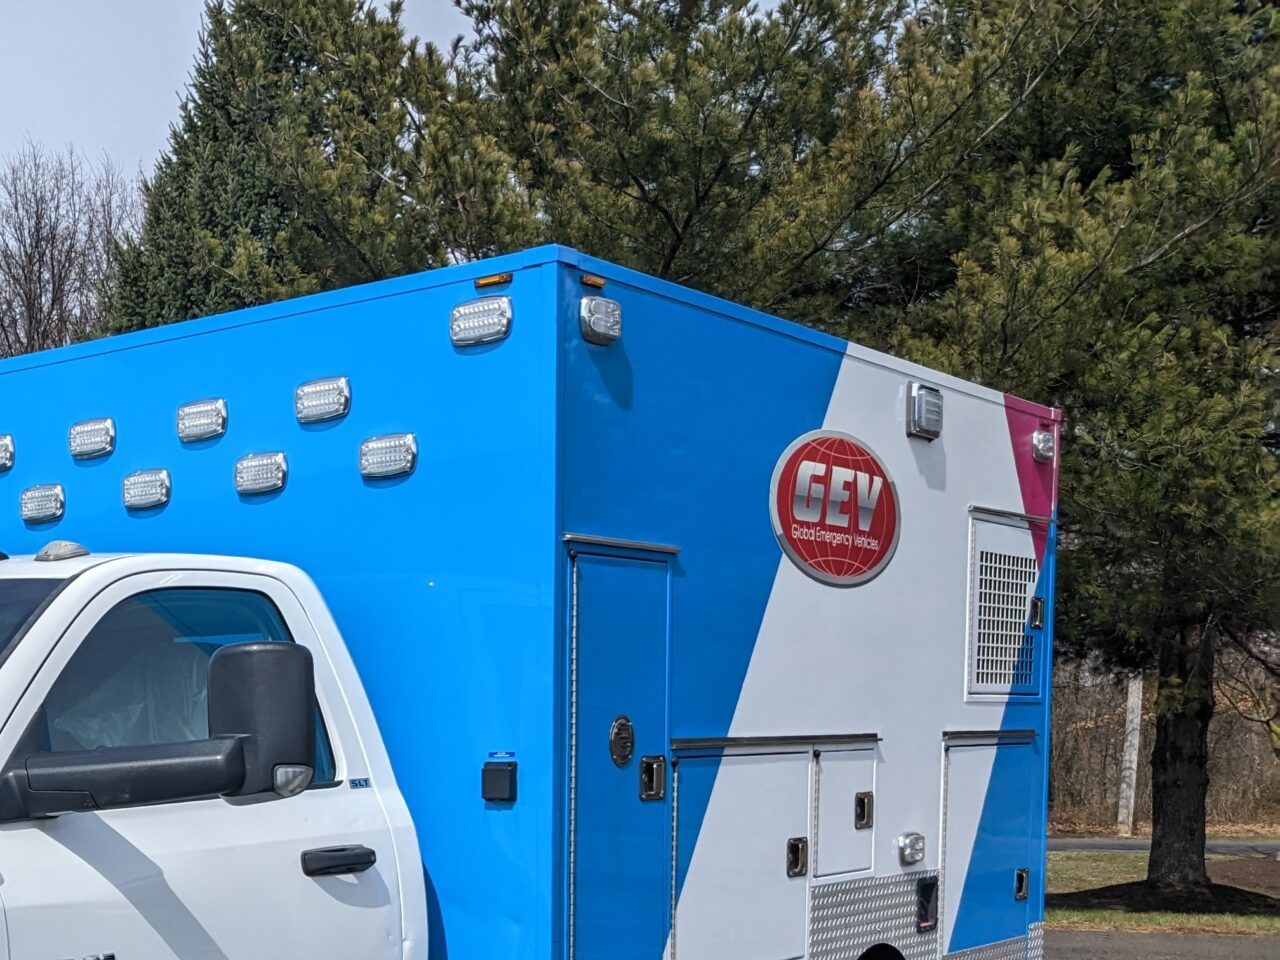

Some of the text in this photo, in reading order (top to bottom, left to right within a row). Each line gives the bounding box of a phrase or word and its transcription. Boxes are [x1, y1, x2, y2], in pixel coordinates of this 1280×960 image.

[793, 460, 883, 532] GEV
[791, 524, 880, 551] Global Emergency Vehicles
[351, 779, 369, 787] SLT
